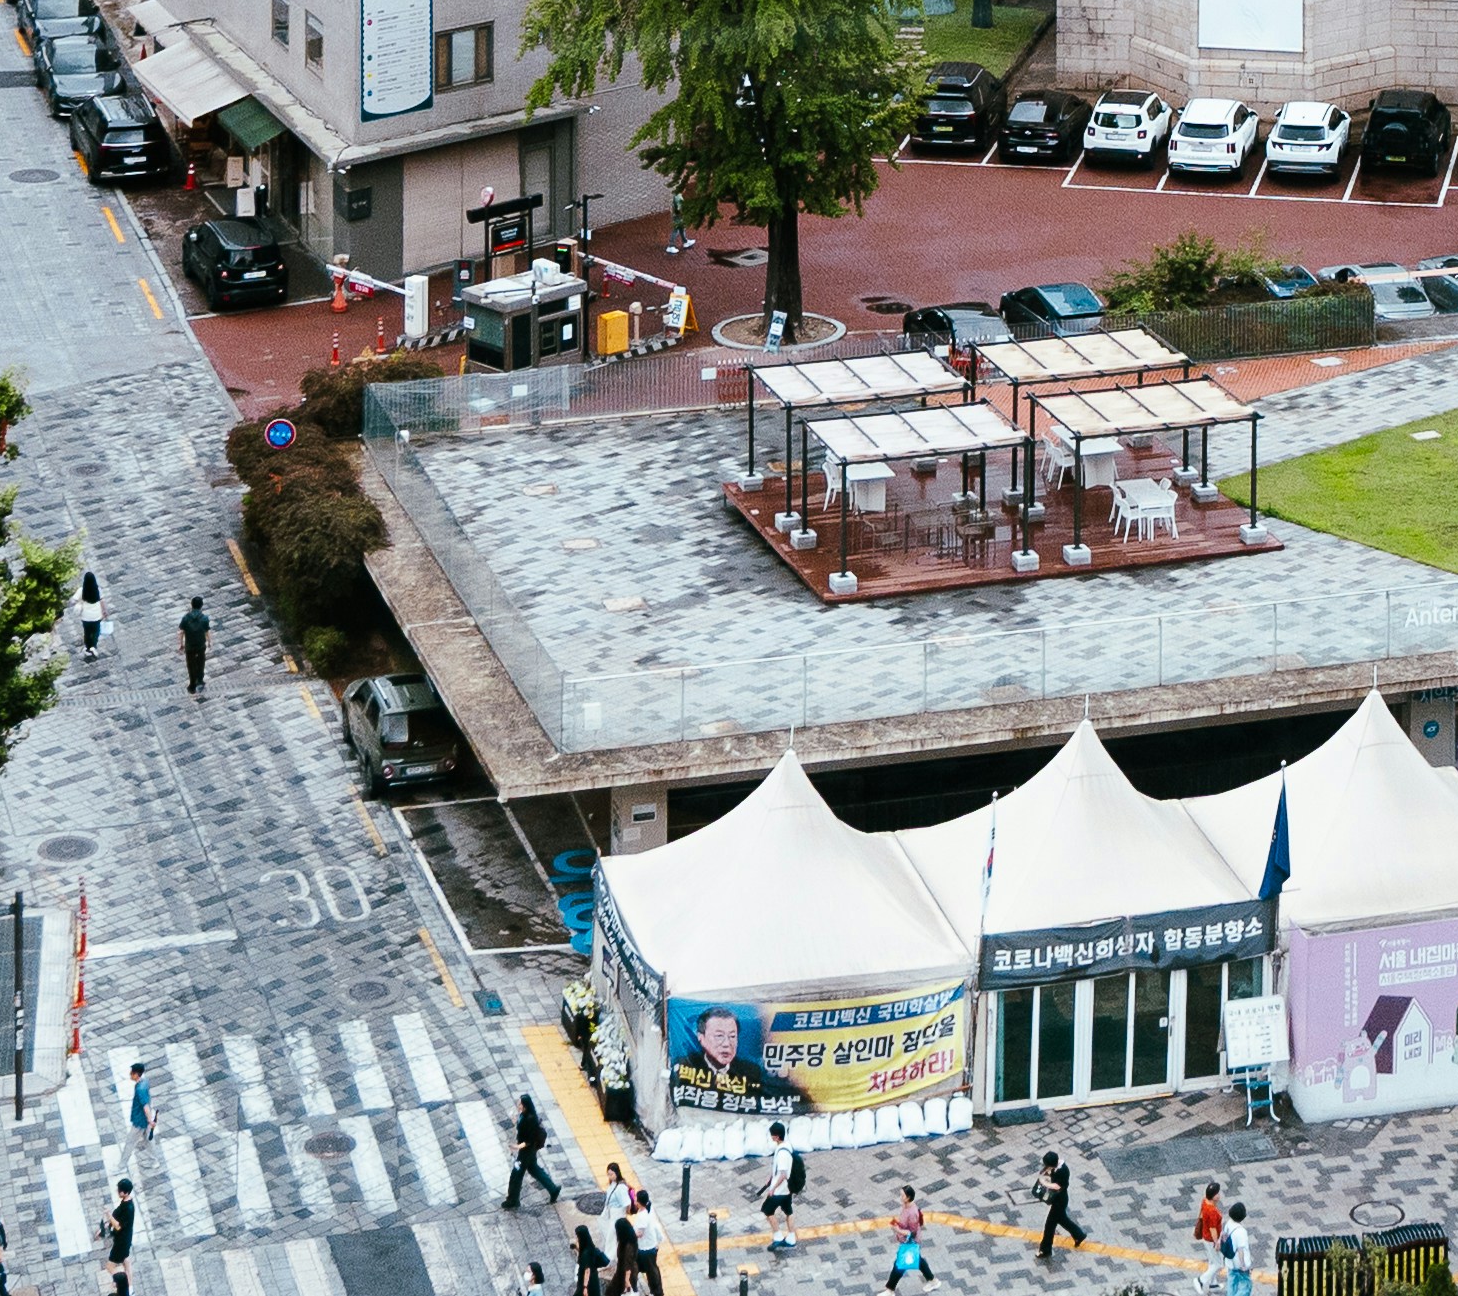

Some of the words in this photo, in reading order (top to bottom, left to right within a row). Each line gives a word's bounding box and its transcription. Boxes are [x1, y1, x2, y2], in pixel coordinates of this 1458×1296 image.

[260, 865, 372, 928] 30
[992, 930, 1155, 972] 코로나백신희생자
[1163, 915, 1263, 953] 합동분향소
[1379, 950, 1406, 970] 서울
[793, 1008, 871, 1028] 코로나백신
[765, 1043, 826, 1068] 민주당
[833, 1034, 895, 1066] 살인마
[902, 1014, 956, 1053] 집단을
[1404, 1030, 1422, 1046] 미리
[1404, 1047, 1422, 1060] 내집
[866, 1049, 955, 1094] 처단하라!
[722, 1091, 757, 1112] 정부
